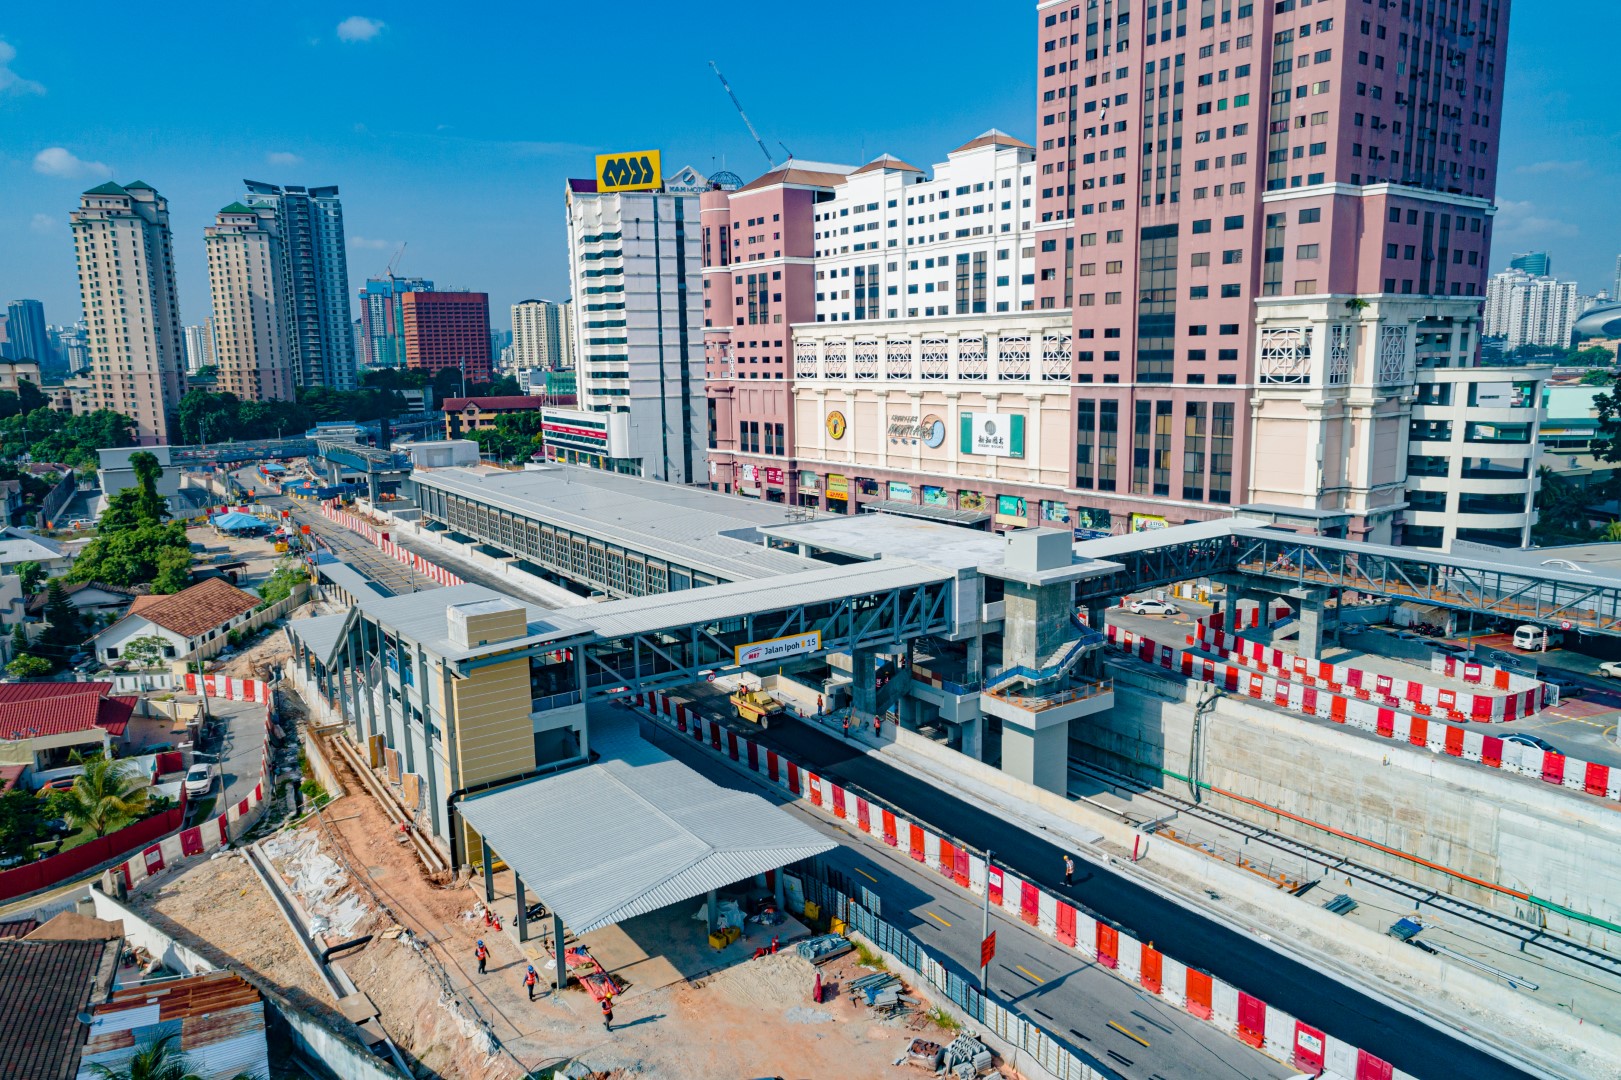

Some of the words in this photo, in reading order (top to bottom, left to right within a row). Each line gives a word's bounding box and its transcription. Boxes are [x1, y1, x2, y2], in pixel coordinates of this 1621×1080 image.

[829, 491, 845, 499] DHL
[764, 645, 784, 655] Jalan
[784, 641, 800, 653] Ipoh
[806, 637, 816, 647] 15
[748, 652, 760, 660] MRT
